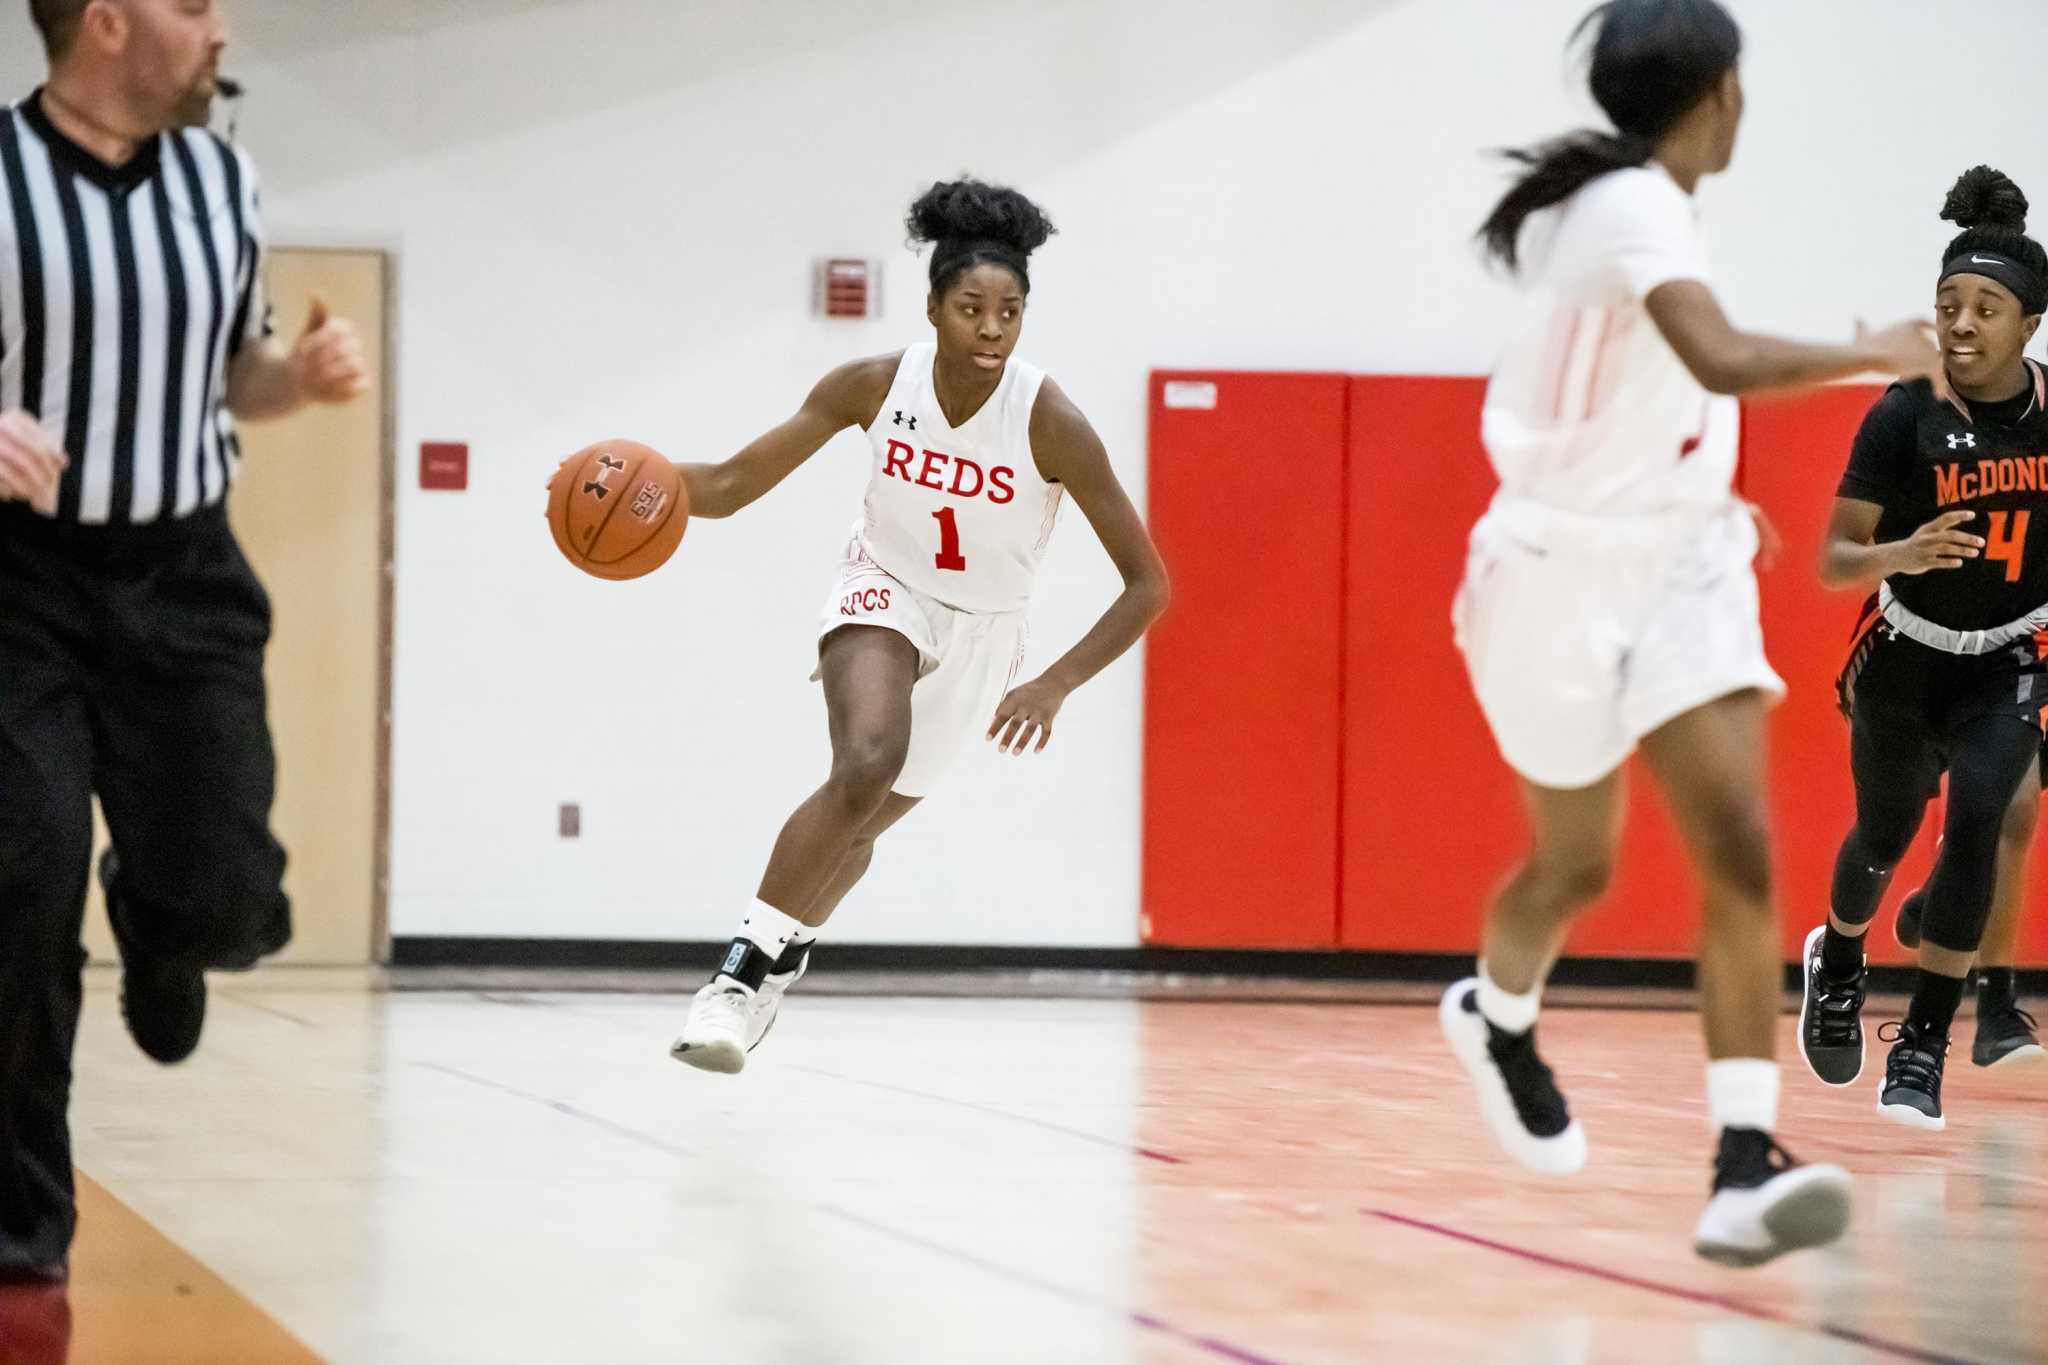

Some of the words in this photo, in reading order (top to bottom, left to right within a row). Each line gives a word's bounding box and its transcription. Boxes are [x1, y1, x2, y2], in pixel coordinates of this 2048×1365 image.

[630, 481, 659, 518] 695
[882, 438, 1015, 504] REDS
[931, 506, 966, 571] 1
[1985, 510, 2032, 582] 4
